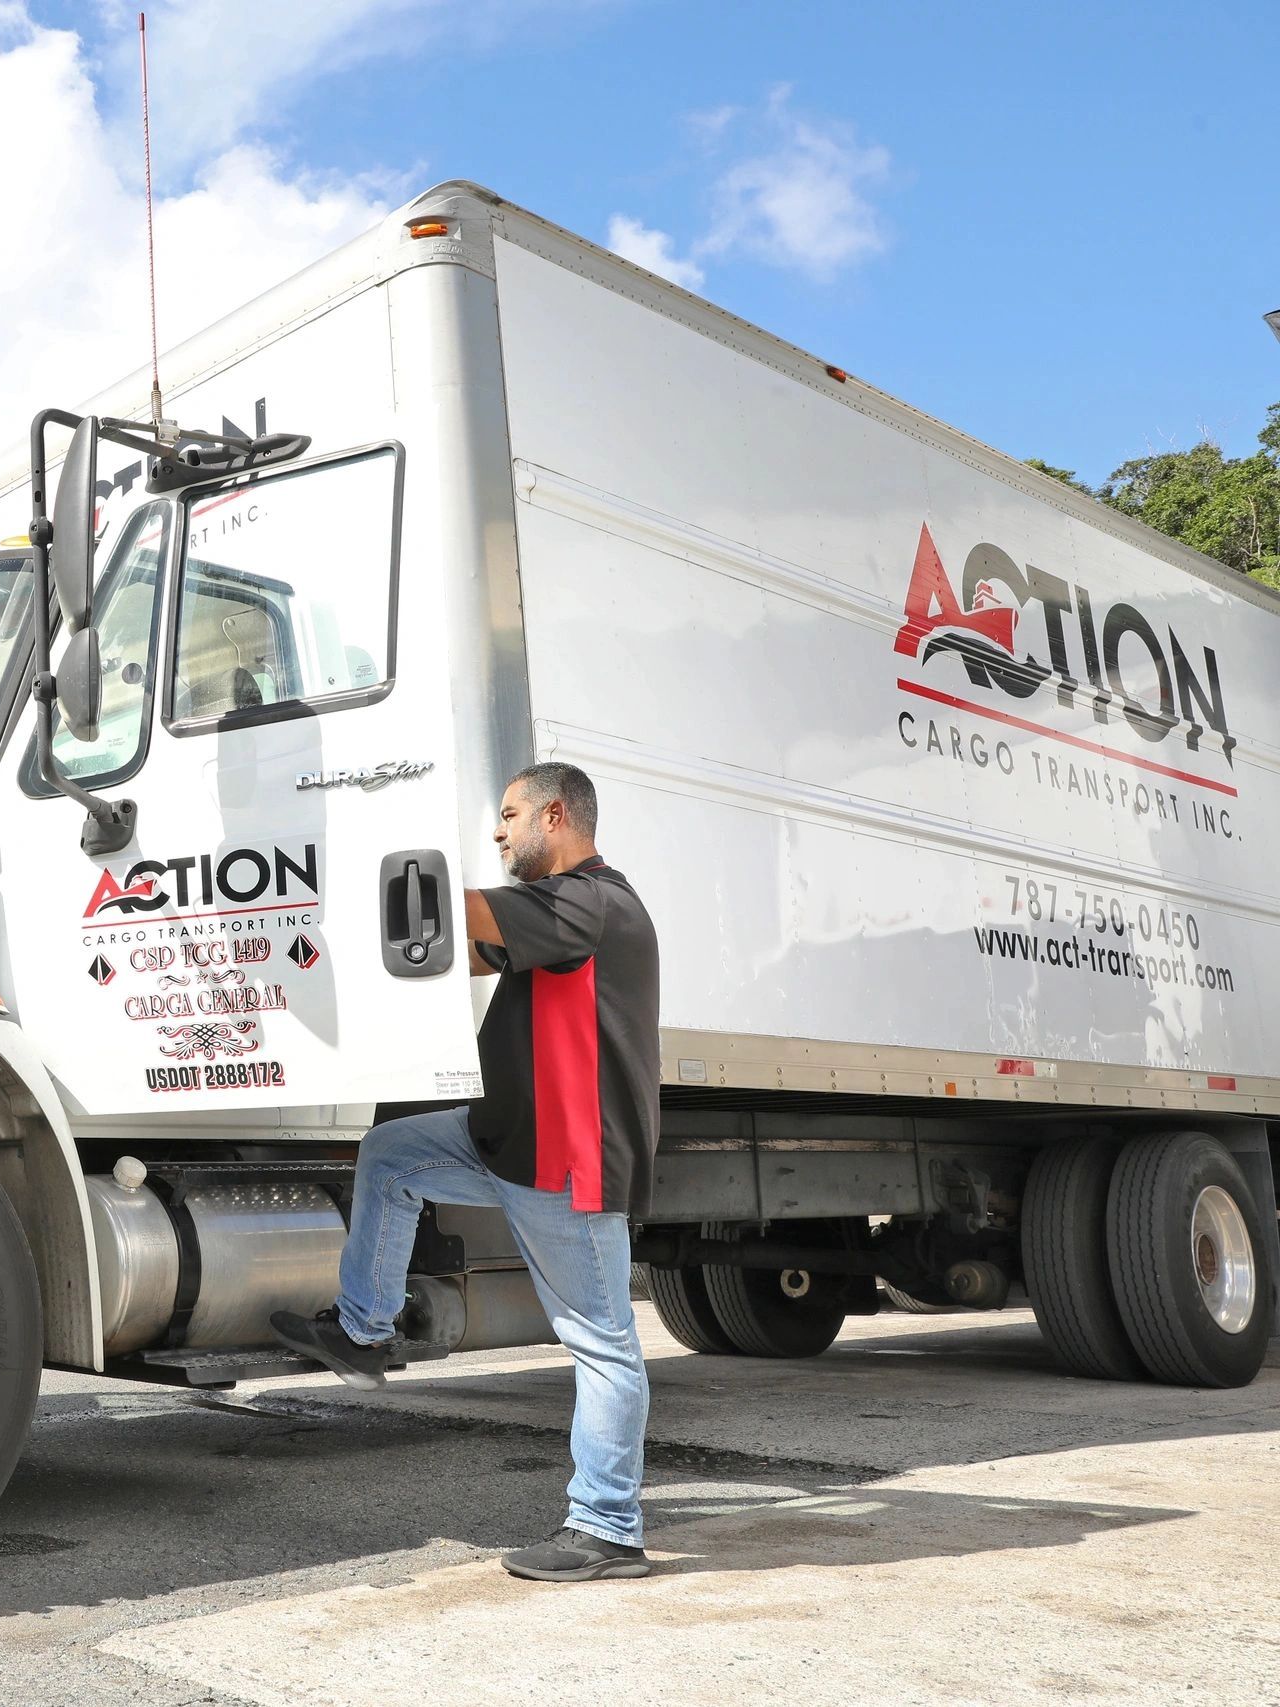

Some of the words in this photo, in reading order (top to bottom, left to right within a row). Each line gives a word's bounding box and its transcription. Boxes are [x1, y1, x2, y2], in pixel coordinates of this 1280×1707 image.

[222, 505, 268, 535] INC.
[893, 520, 1236, 772] ACTION
[897, 711, 1014, 776] CARGO
[1031, 750, 1180, 823] TRANSPORT
[1193, 800, 1243, 842] INC.
[82, 843, 318, 918] ACTION
[82, 930, 146, 947] CARGO
[158, 918, 265, 938] TRANSPORT
[277, 913, 320, 928] INC.
[1005, 874, 1200, 951] 787-750-0450
[180, 941, 228, 968] TCG
[232, 937, 271, 964] 1419
[973, 925, 1235, 992] www.act-transport.com
[124, 993, 195, 1020] CARGA
[197, 984, 287, 1015] GENERAL
[145, 1066, 201, 1092] USDOT
[204, 1061, 285, 1088] 2888172
